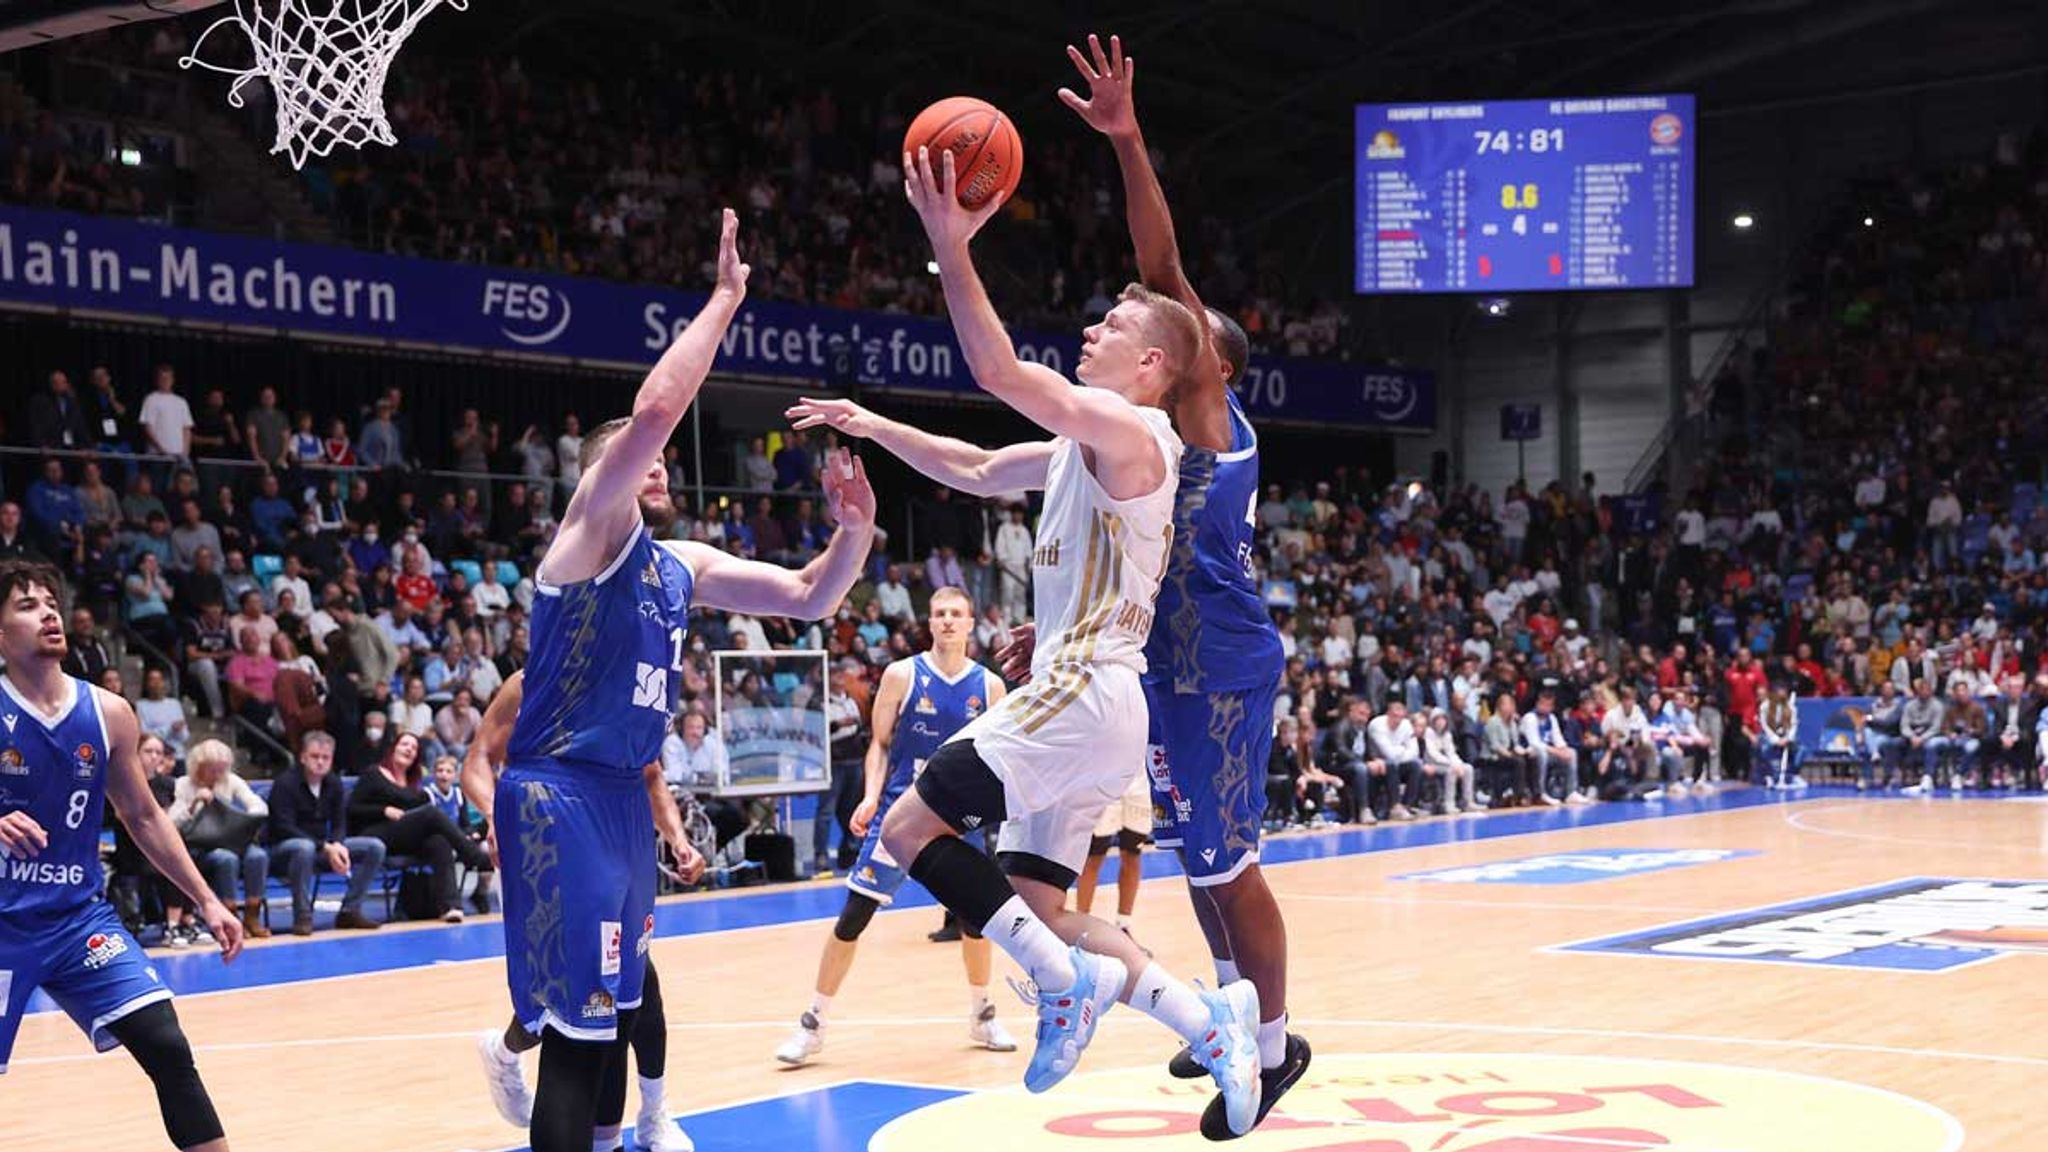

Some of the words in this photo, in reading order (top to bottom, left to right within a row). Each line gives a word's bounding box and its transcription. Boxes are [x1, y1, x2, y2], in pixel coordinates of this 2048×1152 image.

[1512, 214, 1526, 236] 4
[483, 279, 550, 321] FES
[1364, 375, 1404, 402] FES
[65, 789, 89, 829] 8
